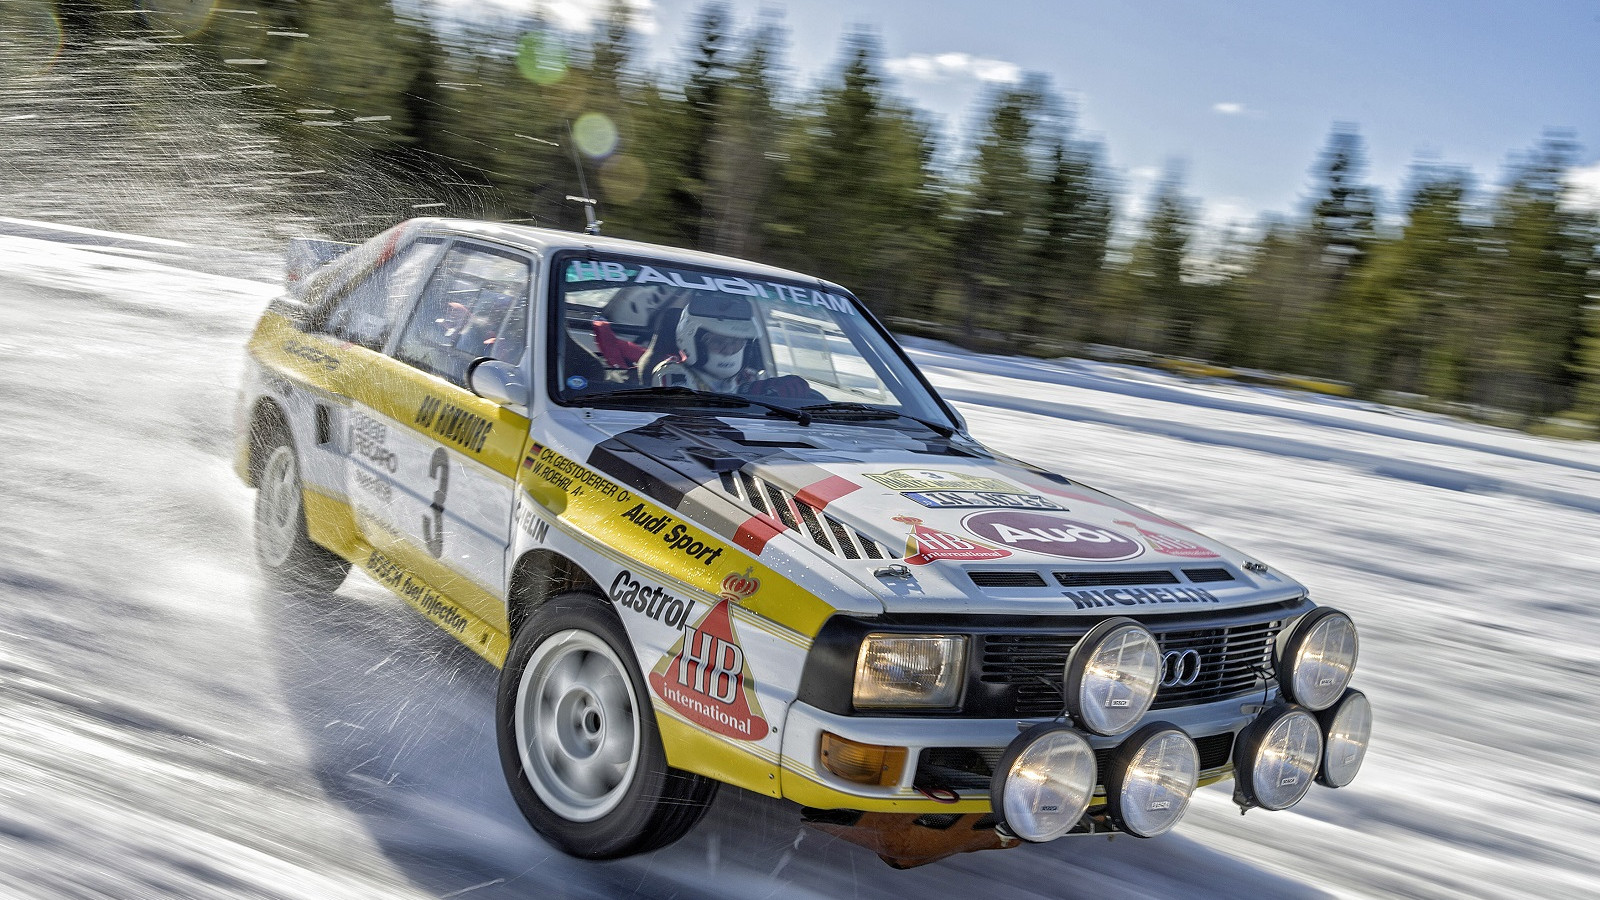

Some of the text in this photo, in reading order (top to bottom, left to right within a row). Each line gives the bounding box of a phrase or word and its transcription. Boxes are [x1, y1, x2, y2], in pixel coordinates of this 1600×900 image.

[571, 260, 629, 282] HB
[766, 282, 855, 316] TEAM
[532, 461, 573, 492] W.ROEHRL
[540, 448, 619, 498] CH.GEISTDOERFER
[920, 471, 945, 480] 3
[422, 447, 449, 559] 3
[620, 502, 724, 567] Audi Sport
[908, 533, 976, 550] HB
[921, 550, 1003, 562] international
[400, 575, 425, 603] fuel
[420, 589, 468, 634] injection
[609, 569, 696, 632] Castrol
[1061, 587, 1220, 610] MICHELIN
[677, 624, 745, 706] HB
[663, 682, 752, 736] international
